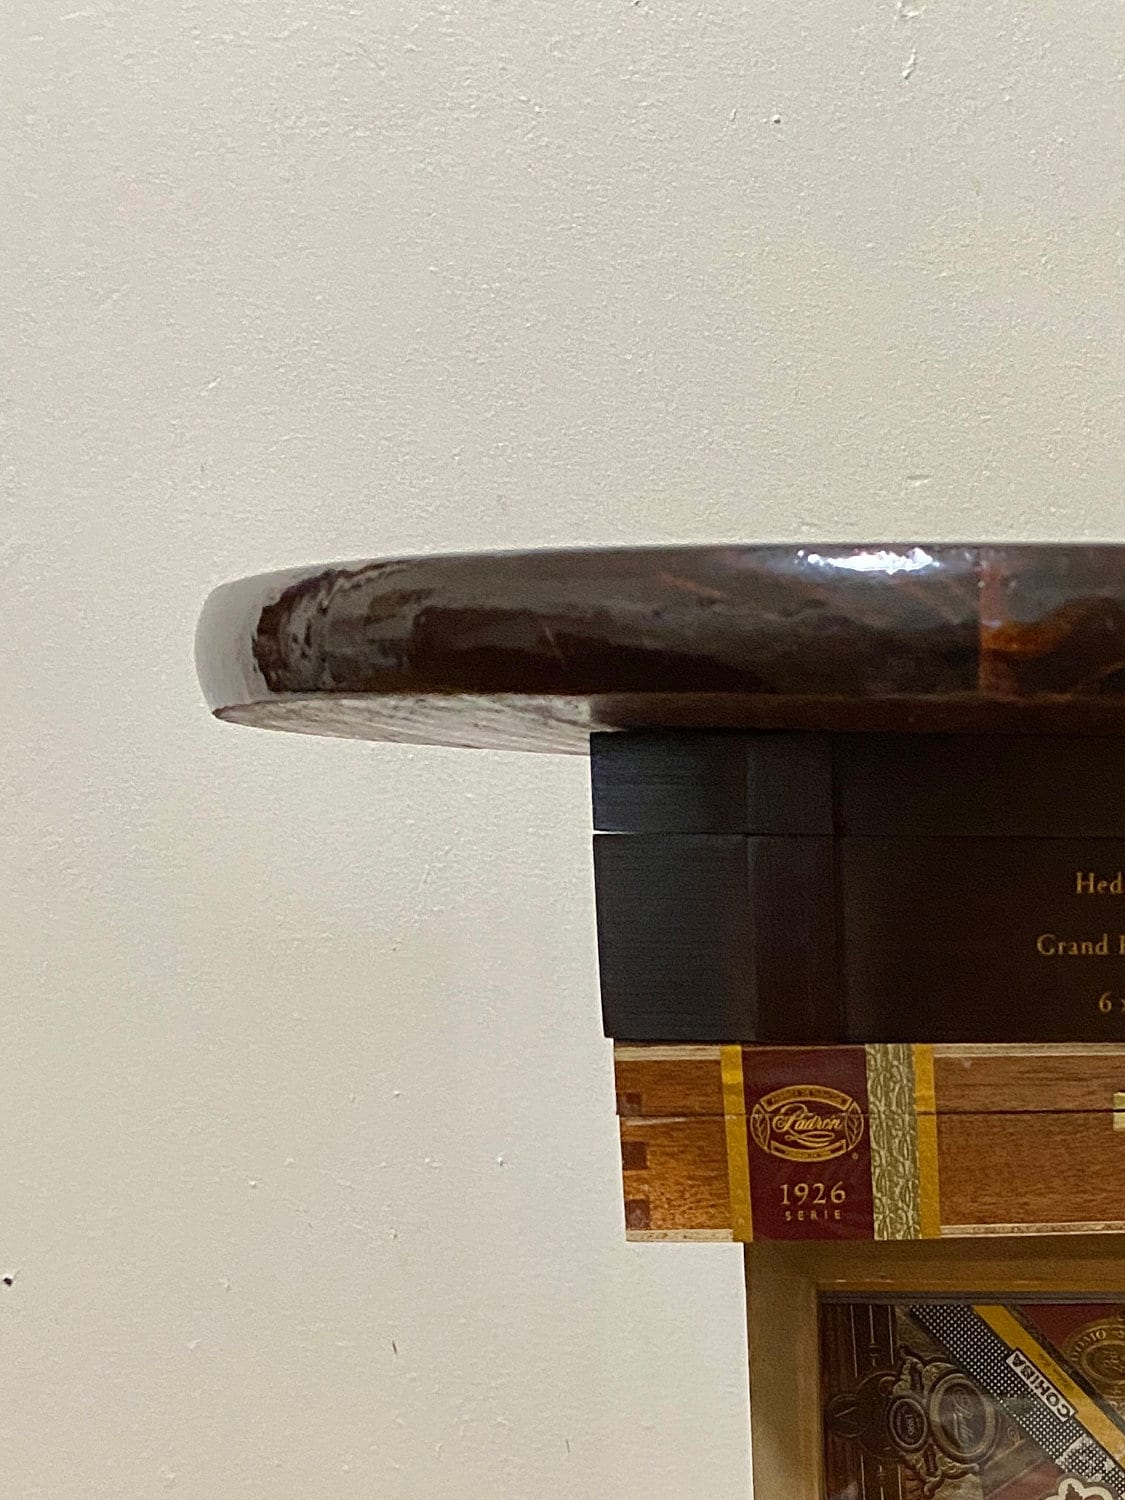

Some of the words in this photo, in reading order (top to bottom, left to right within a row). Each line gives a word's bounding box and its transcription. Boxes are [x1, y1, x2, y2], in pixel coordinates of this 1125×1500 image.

[1036, 933, 1109, 956] Grand
[1098, 991, 1112, 1014] 6
[780, 1181, 846, 1205] 1926
[785, 1209, 841, 1221] SERIE
[1011, 1352, 1073, 1420] COHIBA
